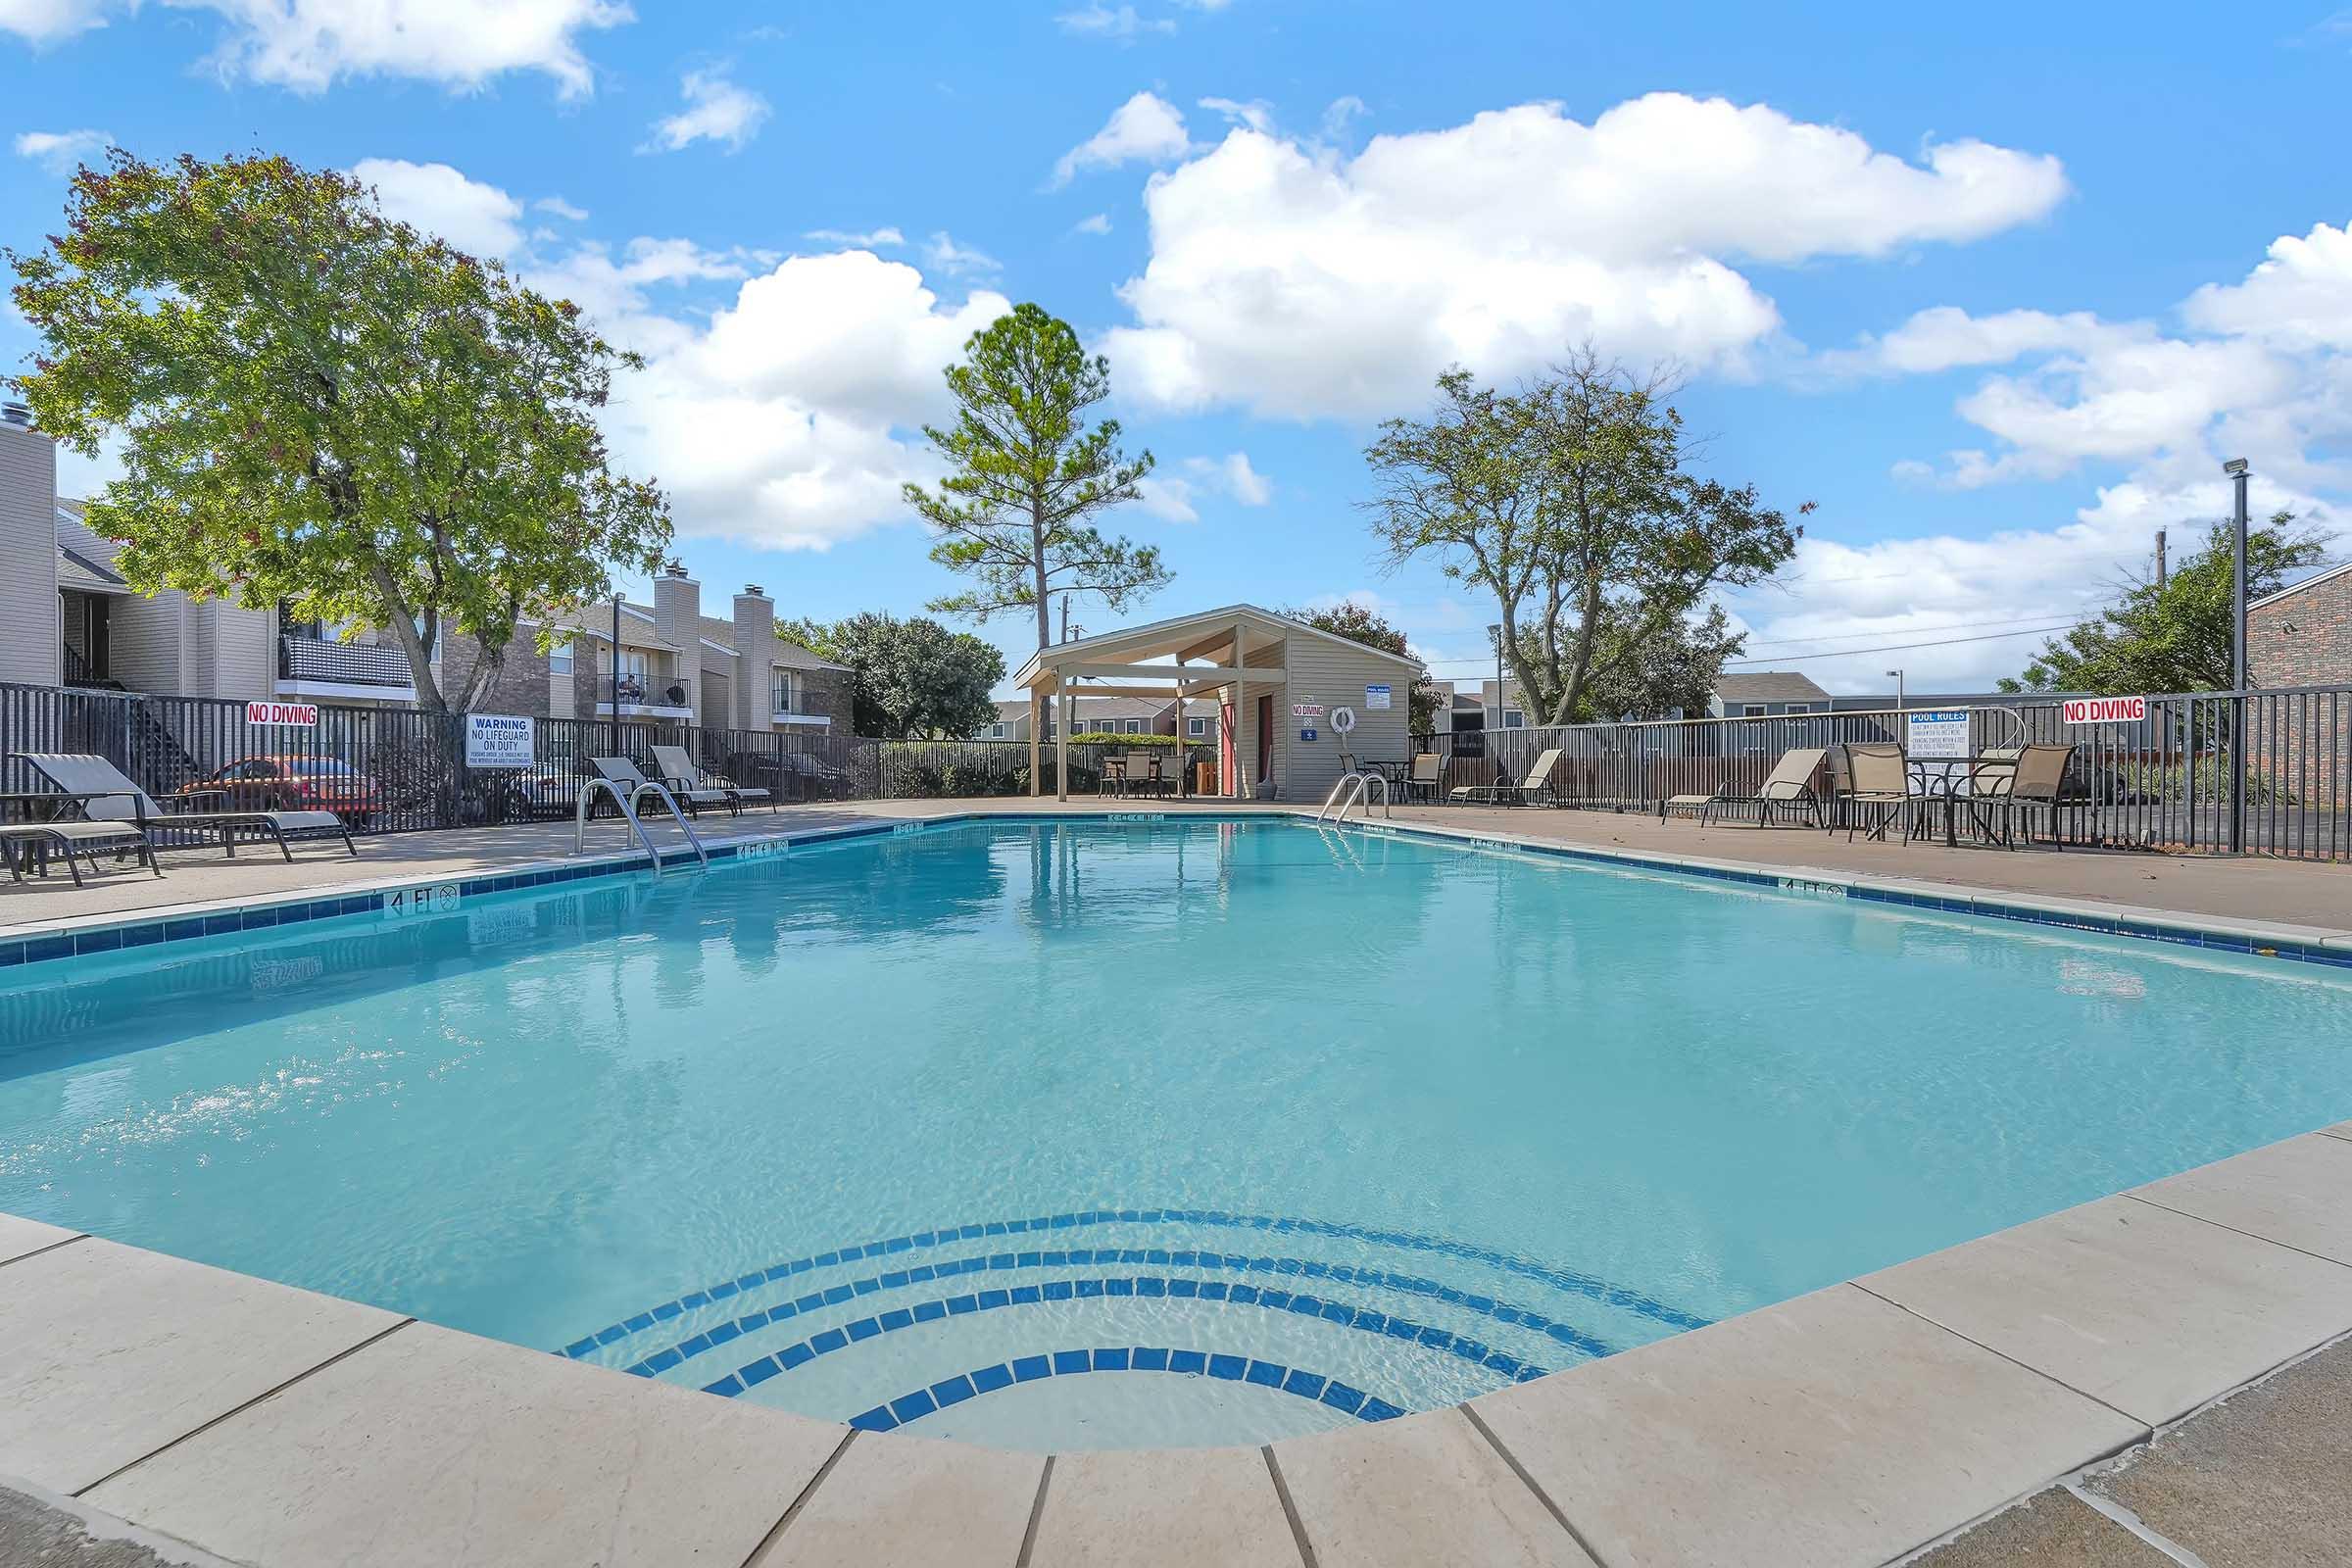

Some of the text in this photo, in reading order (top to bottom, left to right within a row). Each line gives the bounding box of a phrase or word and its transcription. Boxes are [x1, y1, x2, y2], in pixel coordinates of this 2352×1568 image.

[248, 704, 316, 724] NO DIVING
[1294, 706, 1323, 715] NO DIVING
[2065, 699, 2143, 721] NO DIVING
[1912, 711, 1965, 722] POOL RULES
[475, 718, 526, 730] WARNING
[471, 729, 529, 741] NO LIFEGUARD
[483, 740, 517, 751] ON DUTY
